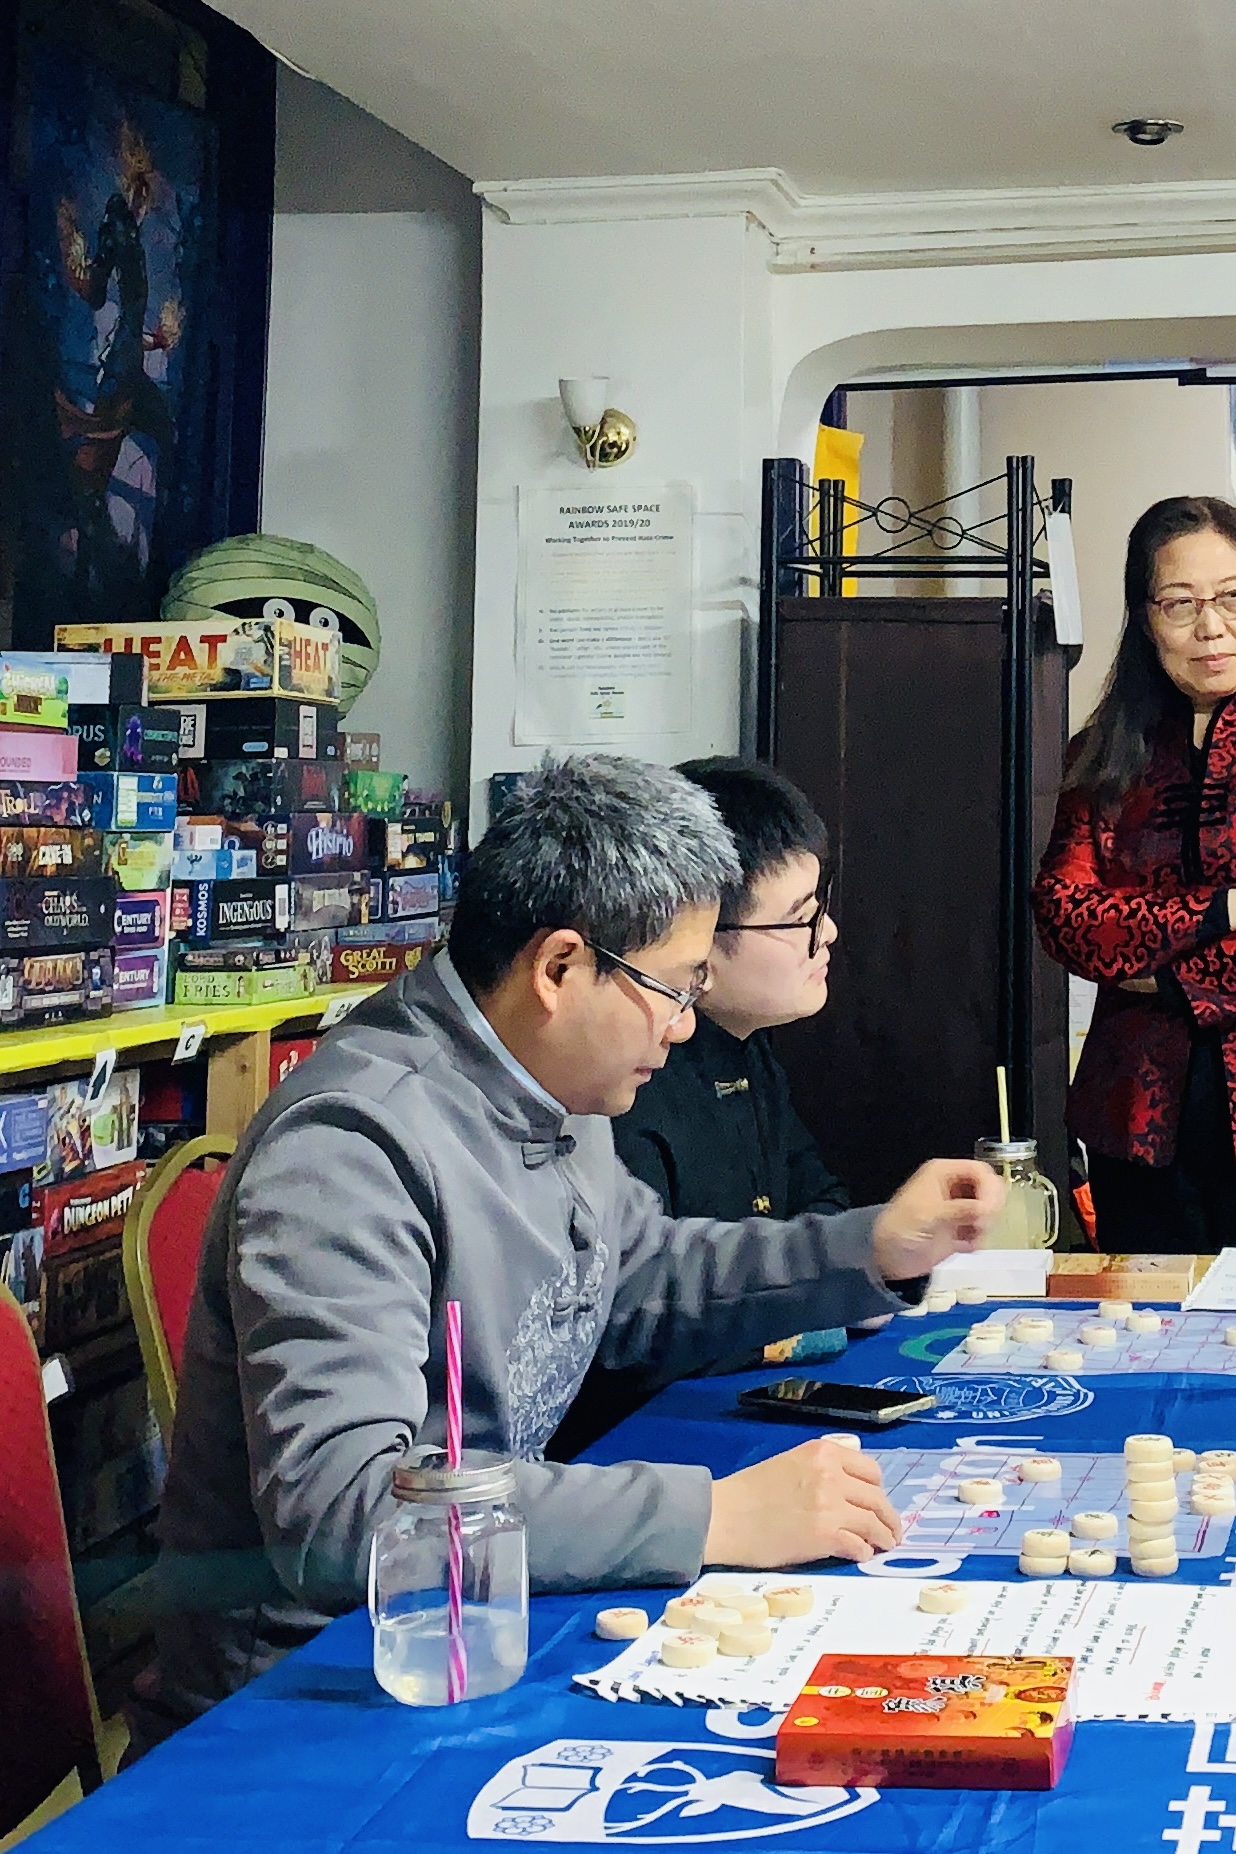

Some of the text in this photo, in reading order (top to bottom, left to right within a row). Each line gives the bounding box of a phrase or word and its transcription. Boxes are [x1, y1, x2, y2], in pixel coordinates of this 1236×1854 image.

[559, 503, 661, 515] RAINBOW SAFE SPACE
[568, 518, 651, 529] AWARDS 2019/20
[293, 636, 330, 674] HEAT
[183, 672, 216, 683] METAL
[196, 882, 209, 937] KOSMOS
[218, 899, 273, 925] INGENIOUS
[114, 909, 152, 934] CENTURY
[339, 946, 387, 967] GREAT
